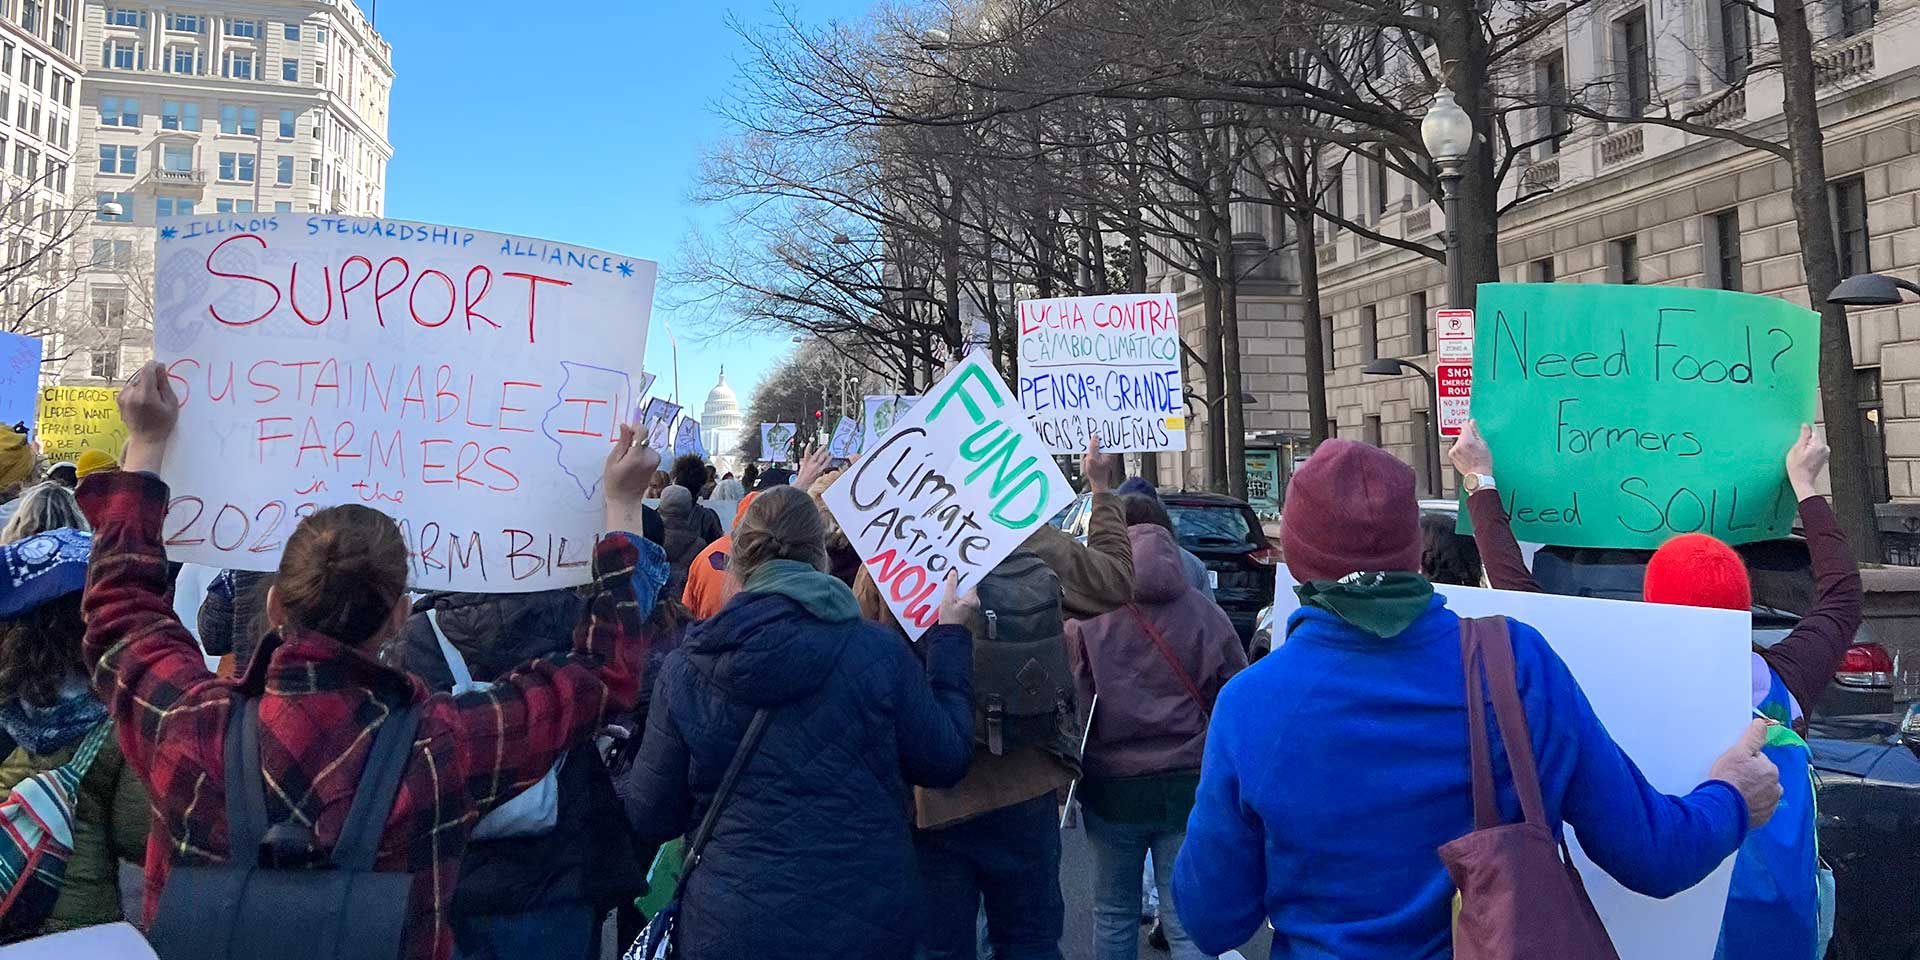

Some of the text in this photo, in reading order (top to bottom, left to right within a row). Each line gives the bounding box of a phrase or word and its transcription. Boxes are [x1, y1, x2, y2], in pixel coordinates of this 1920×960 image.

[182, 216, 612, 272] ILLINOIS STEWARDSHIP ALLIANCE
[206, 233, 573, 344] SUPPORT
[1020, 298, 1178, 335] LUCHA CONTRA
[1022, 332, 1093, 362] CAMBIO
[1095, 332, 1177, 362] CLIMÁTICO
[1447, 368, 1472, 377] SNO
[1491, 309, 1631, 382] Need
[166, 358, 543, 433] SUSTAINABLE
[1020, 372, 1090, 410] PENSA
[1104, 370, 1183, 413] GRANDE
[73, 424, 101, 435] BILL
[256, 416, 520, 492] FARMERS
[925, 362, 1050, 530] FUND
[1557, 397, 1703, 457] Farmers
[351, 480, 404, 504] the
[865, 549, 940, 628] NOW
